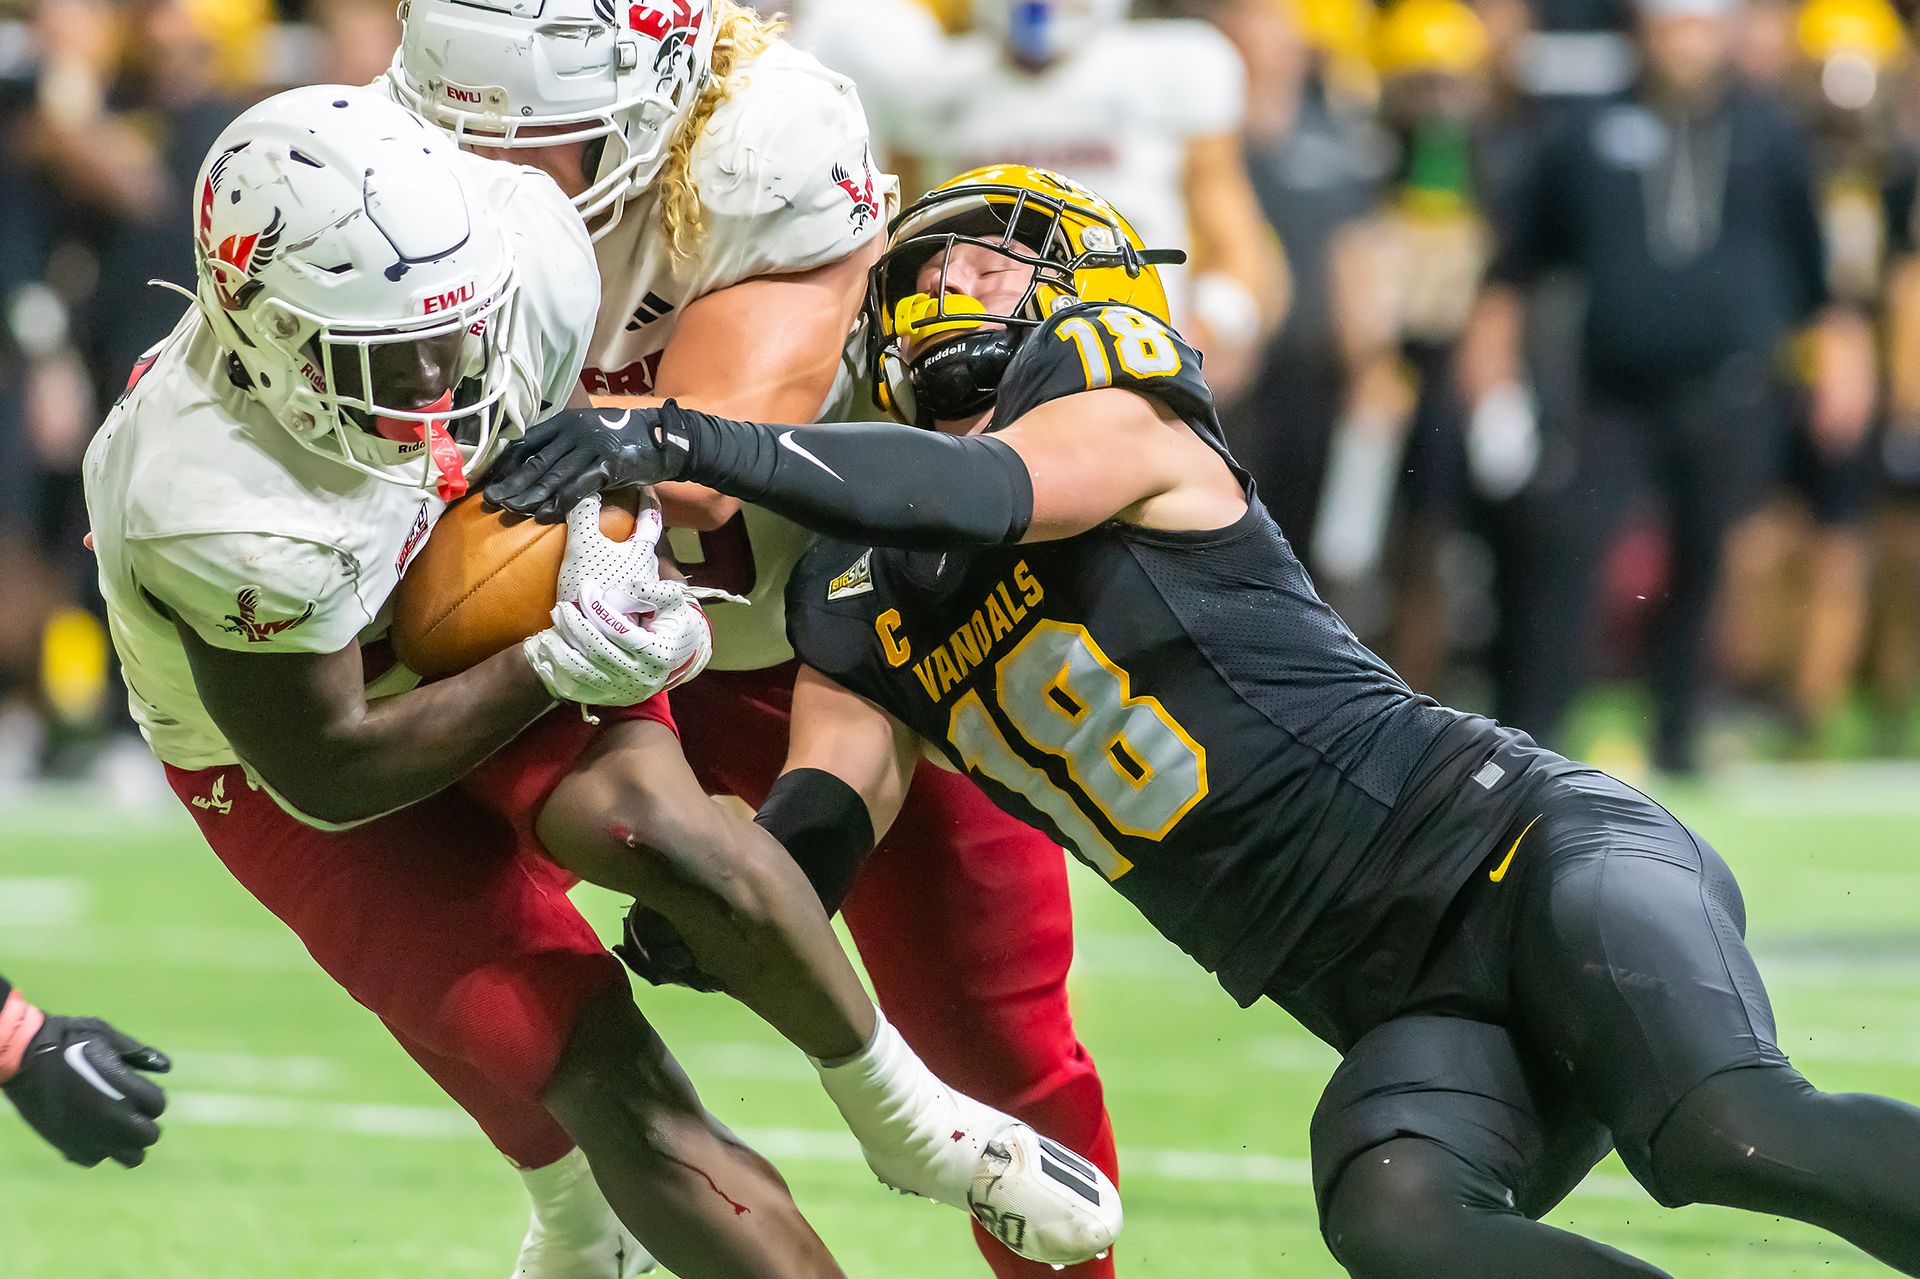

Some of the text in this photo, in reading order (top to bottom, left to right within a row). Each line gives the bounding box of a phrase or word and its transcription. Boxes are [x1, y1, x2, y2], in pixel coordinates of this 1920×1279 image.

[446, 86, 482, 103] EWU
[423, 281, 475, 315] EWU
[924, 342, 966, 368] Riddell
[1055, 303, 1182, 390] 18
[591, 600, 630, 635] ADIZERO
[875, 608, 912, 668] C
[912, 559, 1044, 703] VANDALS
[947, 618, 1209, 881] 18
